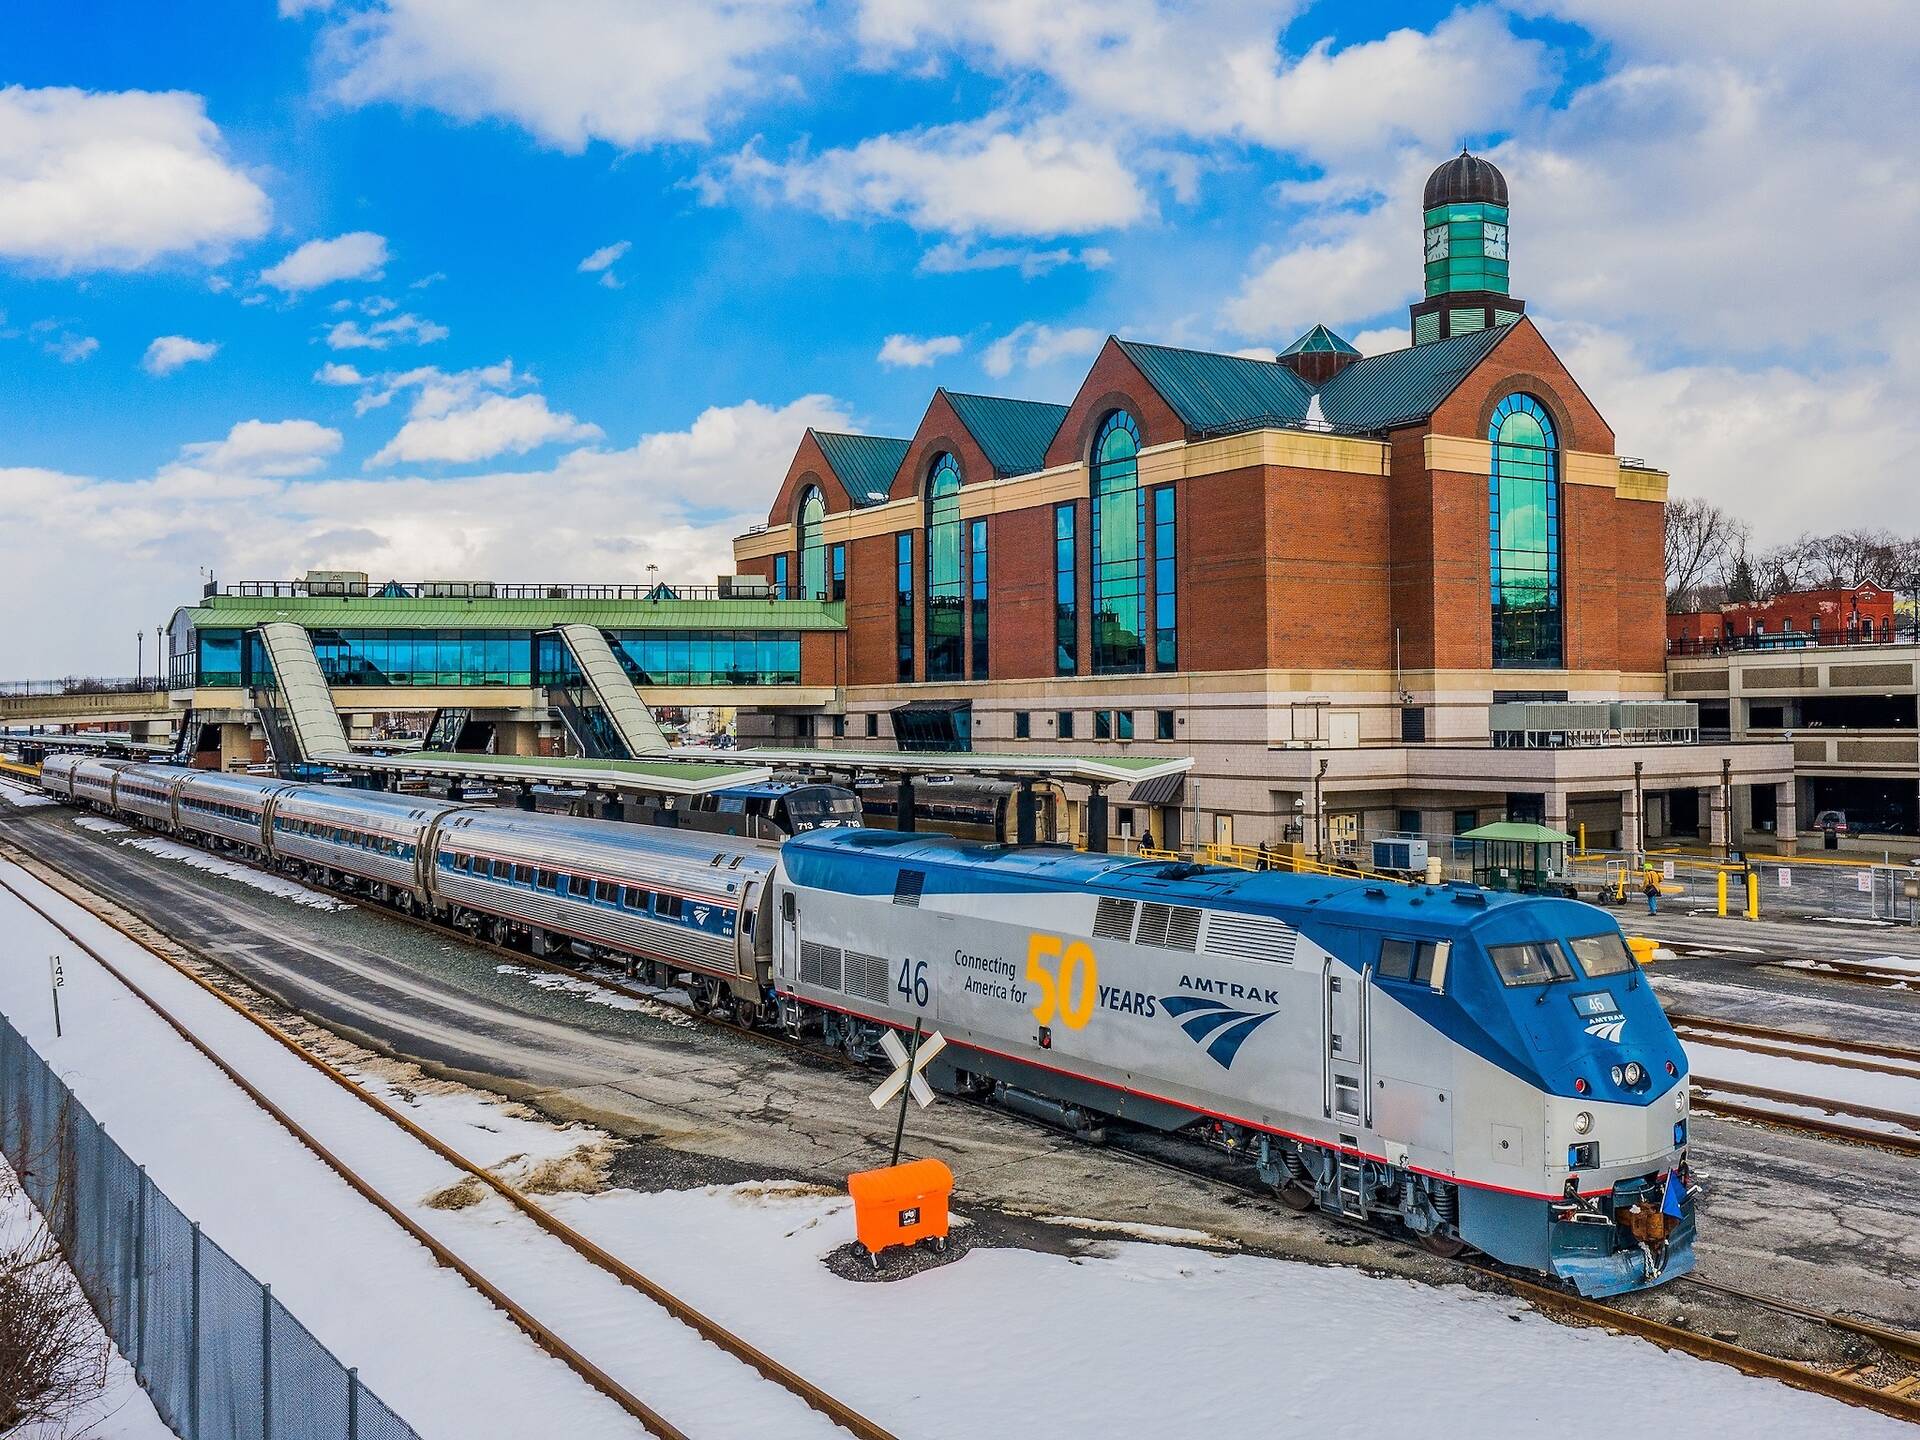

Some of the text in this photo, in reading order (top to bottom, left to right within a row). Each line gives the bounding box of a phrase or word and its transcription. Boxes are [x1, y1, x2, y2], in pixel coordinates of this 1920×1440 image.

[797, 822, 814, 831] 713
[846, 820, 861, 828] 713
[55, 955, 64, 987] 142
[954, 949, 1016, 982] Connecting
[1024, 931, 1098, 1031] 50
[898, 957, 929, 1008] 46
[964, 975, 1028, 1004] America for
[1178, 974, 1280, 1006] AMTRAK
[1099, 984, 1156, 1019] YEARS
[1589, 998, 1605, 1011] 46
[1589, 1014, 1625, 1024] AMTRAK
